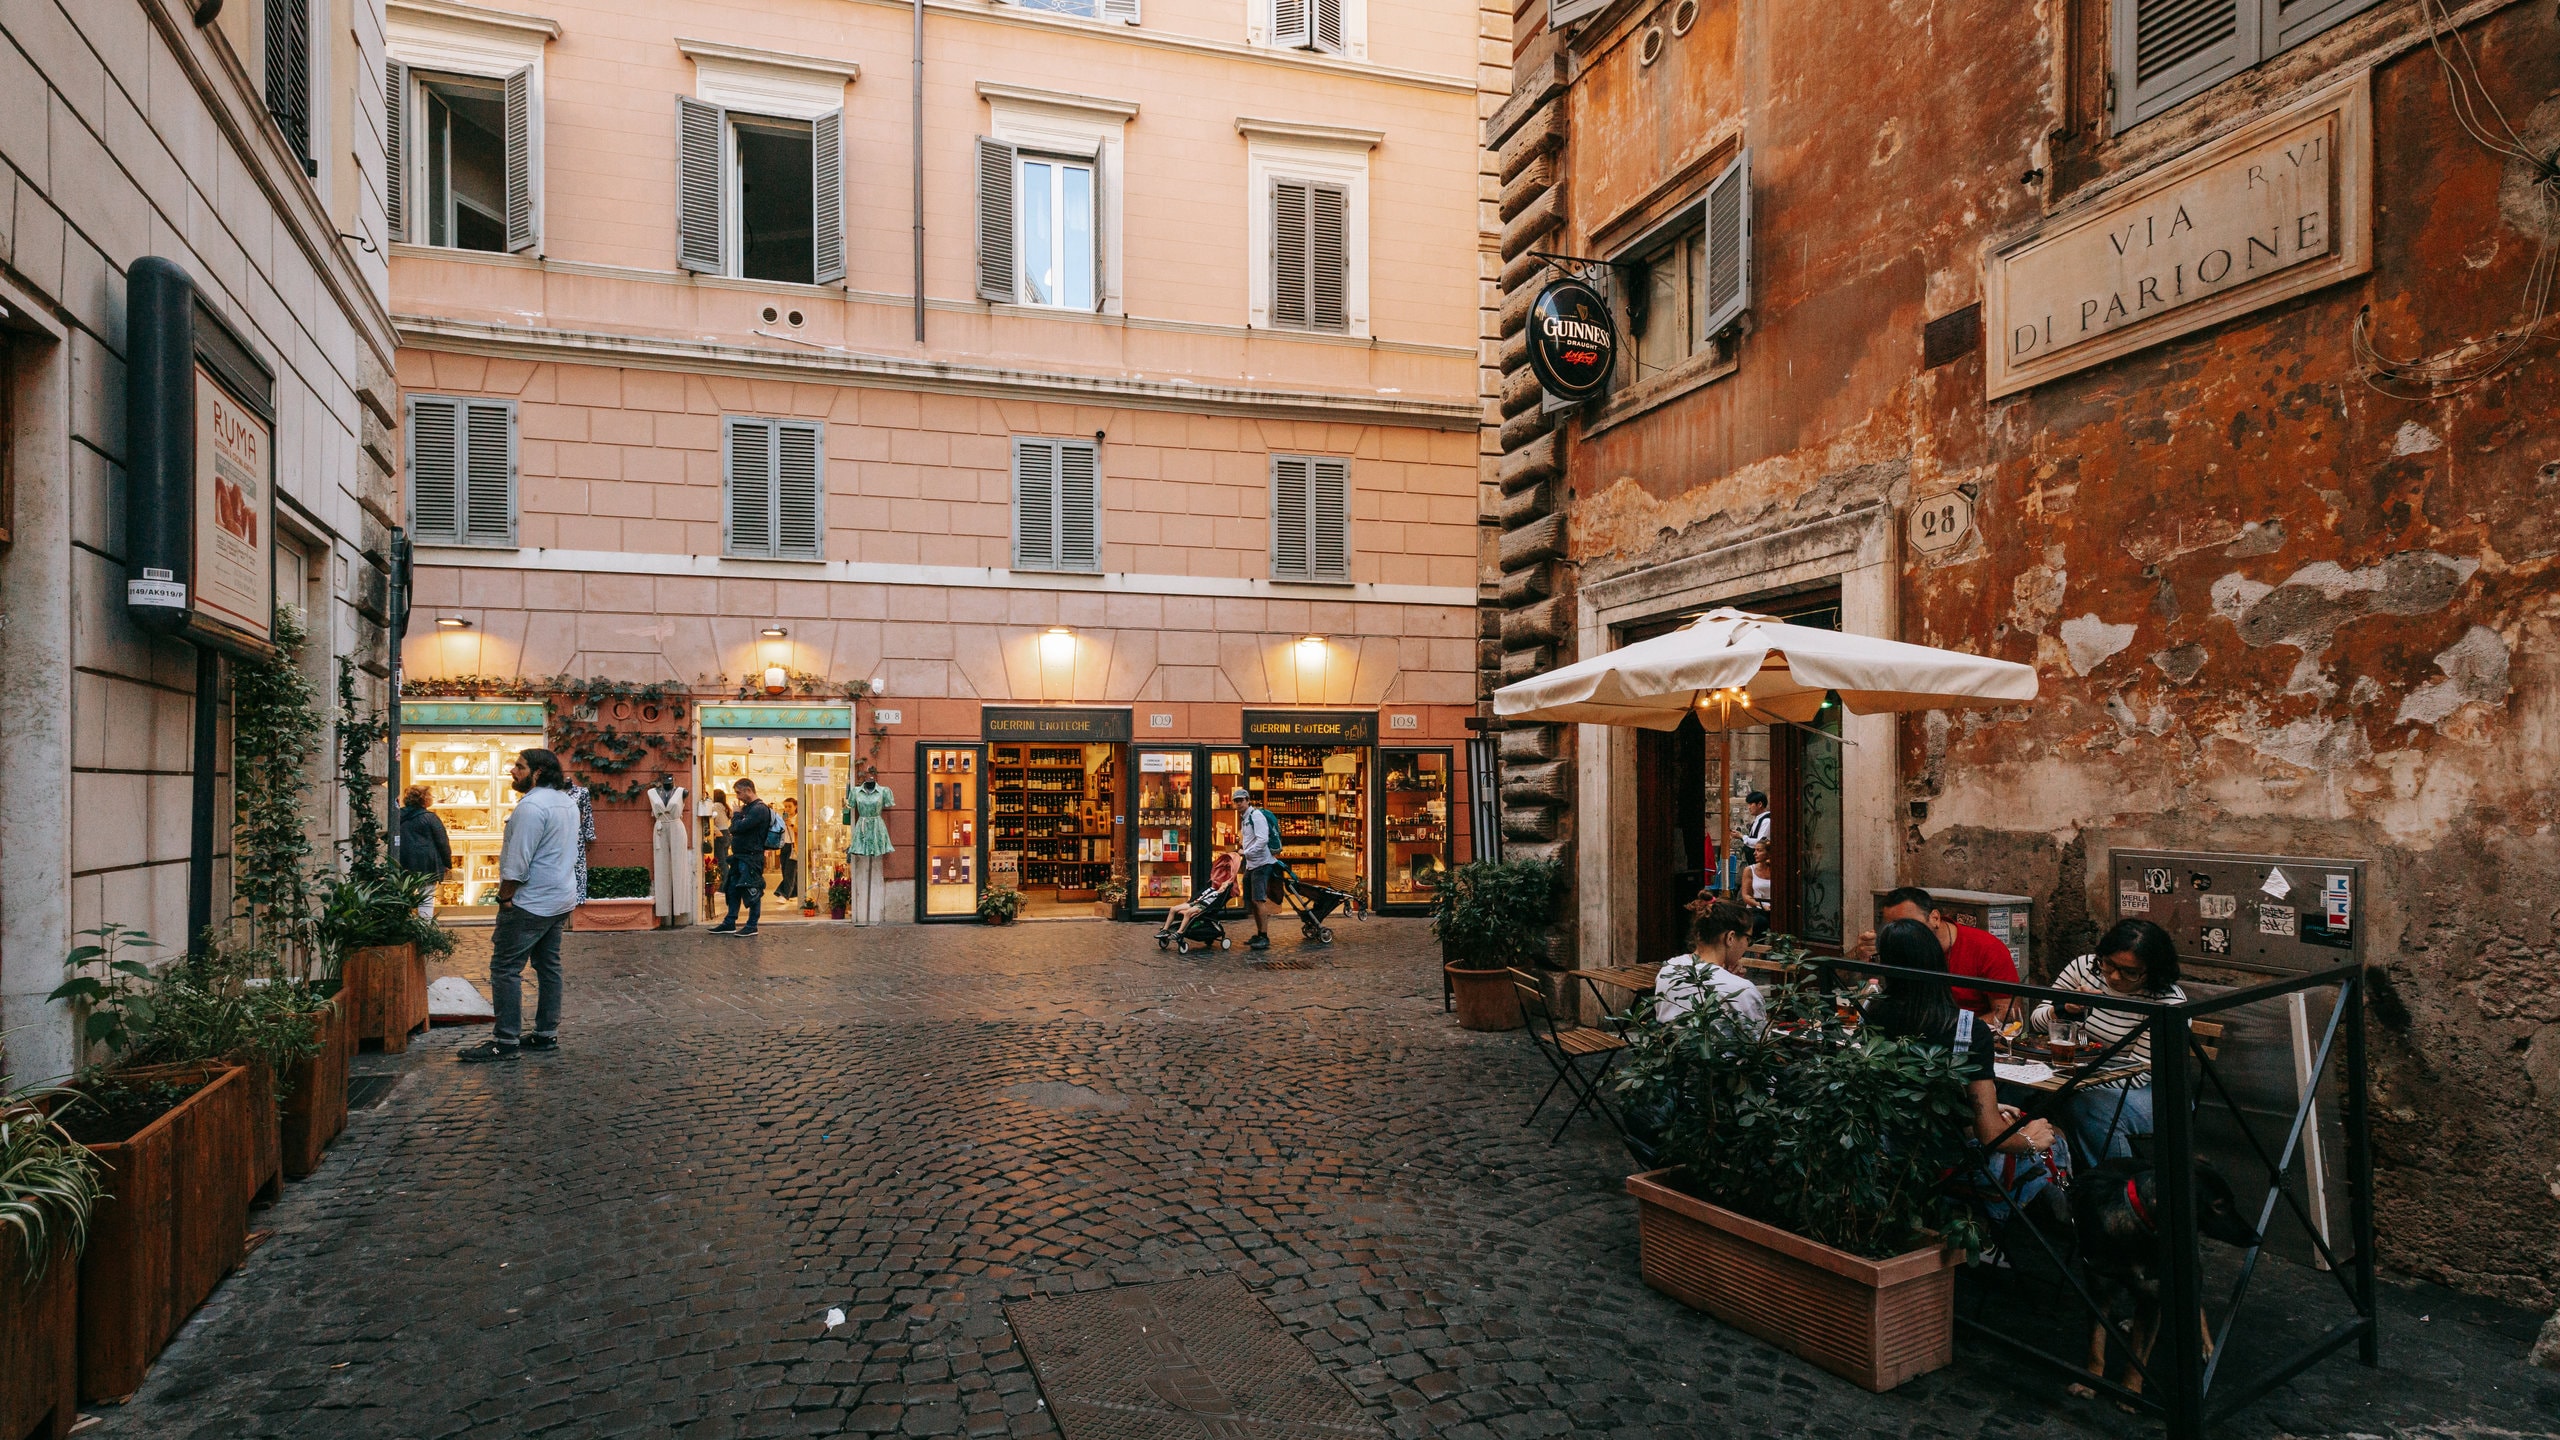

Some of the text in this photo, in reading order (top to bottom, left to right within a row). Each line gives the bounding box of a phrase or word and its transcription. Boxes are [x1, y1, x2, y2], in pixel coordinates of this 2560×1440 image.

[2110, 204, 2196, 256] VIA
[2014, 212, 2322, 356] DI PARIONE
[1543, 316, 1611, 349] GUINNESS
[1566, 339, 1598, 351] DRAUGHT
[213, 400, 257, 465] RUMA
[1921, 505, 1956, 538] 28
[990, 719, 1091, 731] GUERRINI ENOTECHE
[1151, 715, 1172, 727] 109
[1251, 723, 1341, 734] GUERRINI ENOTECHE
[2121, 901, 2149, 909] STEFFI
